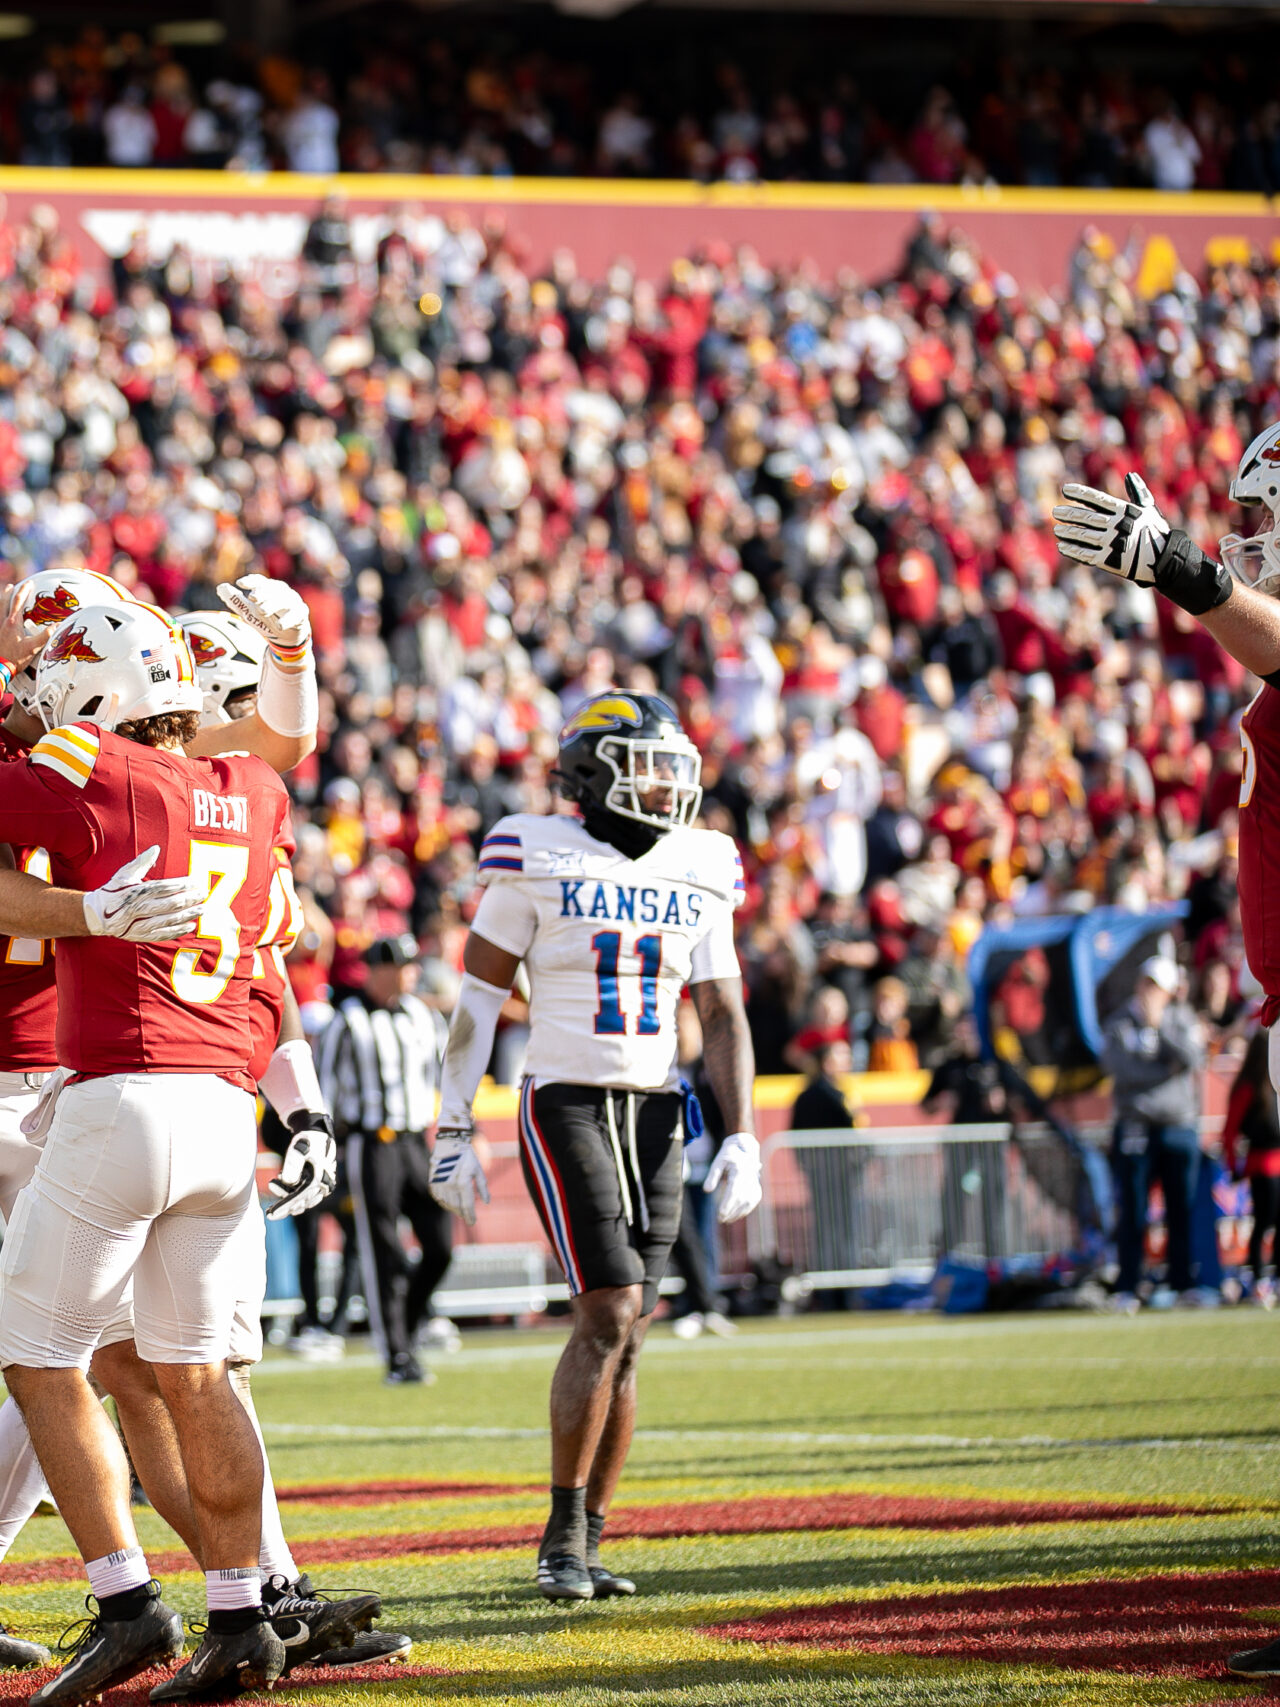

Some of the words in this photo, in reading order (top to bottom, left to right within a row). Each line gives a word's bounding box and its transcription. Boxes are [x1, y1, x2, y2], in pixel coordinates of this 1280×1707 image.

[153, 671, 165, 681] AE
[171, 839, 250, 1003] 3
[559, 879, 703, 927] KANSAS
[591, 929, 662, 1035] 11
